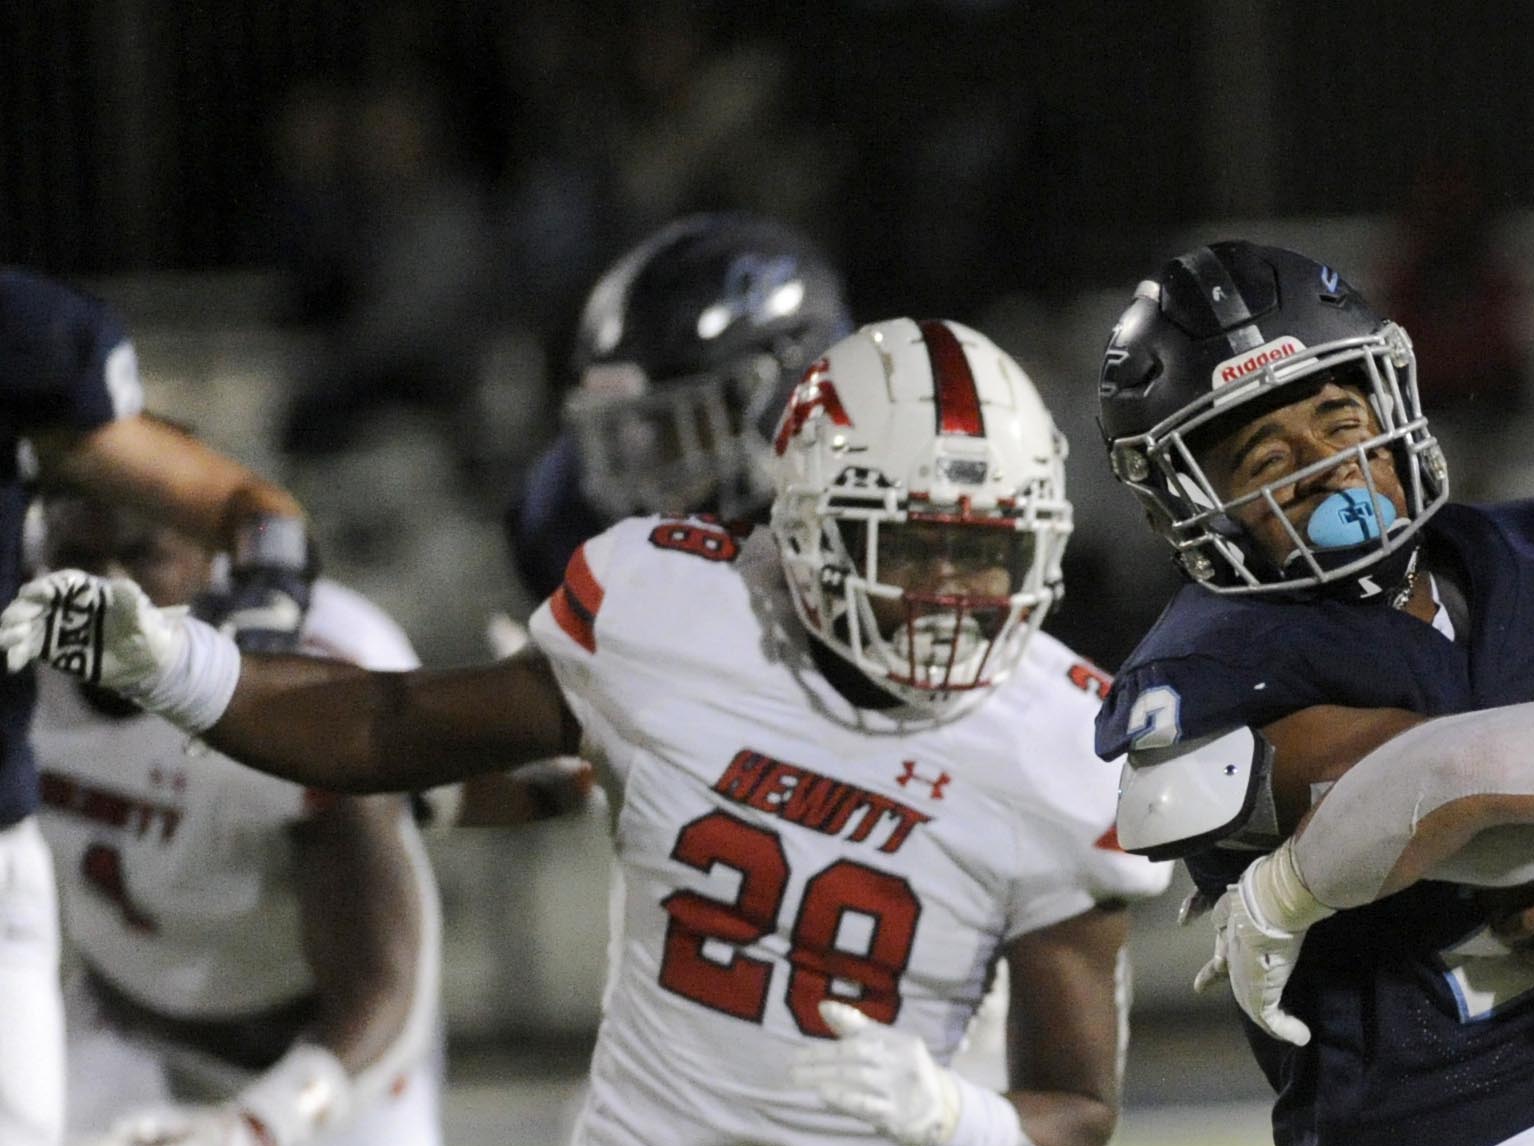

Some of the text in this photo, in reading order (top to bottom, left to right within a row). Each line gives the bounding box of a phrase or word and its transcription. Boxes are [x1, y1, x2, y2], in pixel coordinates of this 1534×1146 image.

[1221, 343, 1296, 382] Riddell
[710, 747, 937, 855] HEWITT
[657, 805, 923, 1040] 28
